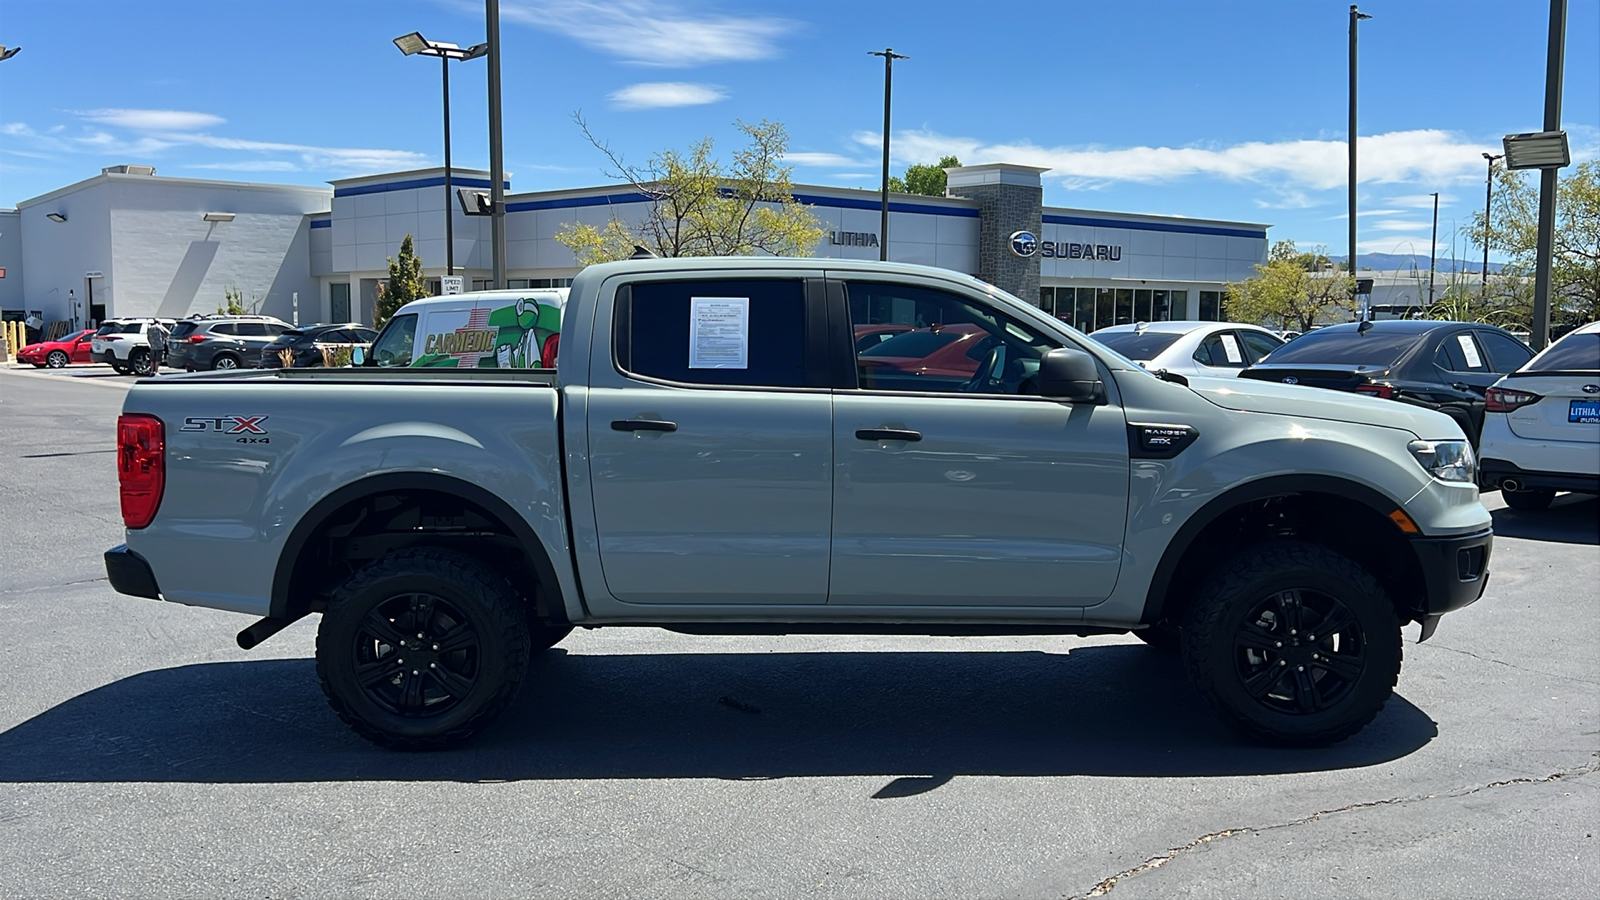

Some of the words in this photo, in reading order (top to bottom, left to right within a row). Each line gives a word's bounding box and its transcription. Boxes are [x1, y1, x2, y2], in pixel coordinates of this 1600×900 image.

[829, 230, 879, 248] LITHIA
[1041, 241, 1121, 261] SUBARU
[425, 330, 497, 354] CARMEDIC
[179, 415, 269, 434] STX
